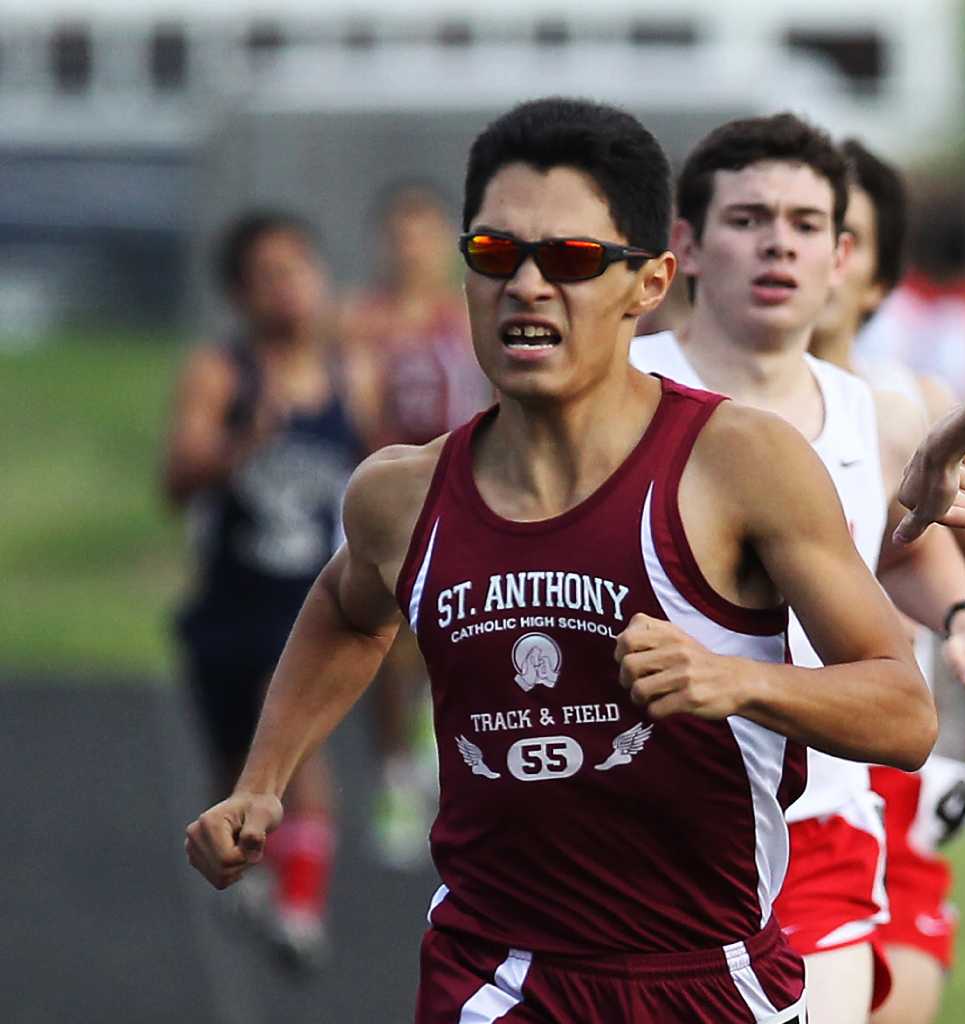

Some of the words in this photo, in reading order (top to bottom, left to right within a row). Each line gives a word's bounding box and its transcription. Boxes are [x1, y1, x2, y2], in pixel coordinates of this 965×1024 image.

[437, 581, 476, 628] ST.
[484, 571, 630, 620] ANTHONY
[450, 618, 517, 643] CATHOLIC
[520, 616, 554, 628] HIGH
[558, 617, 617, 639] SCHOOL
[470, 708, 532, 733] TRACK
[539, 707, 556, 725] &
[562, 703, 620, 724] FIELD
[520, 742, 568, 775] 55
